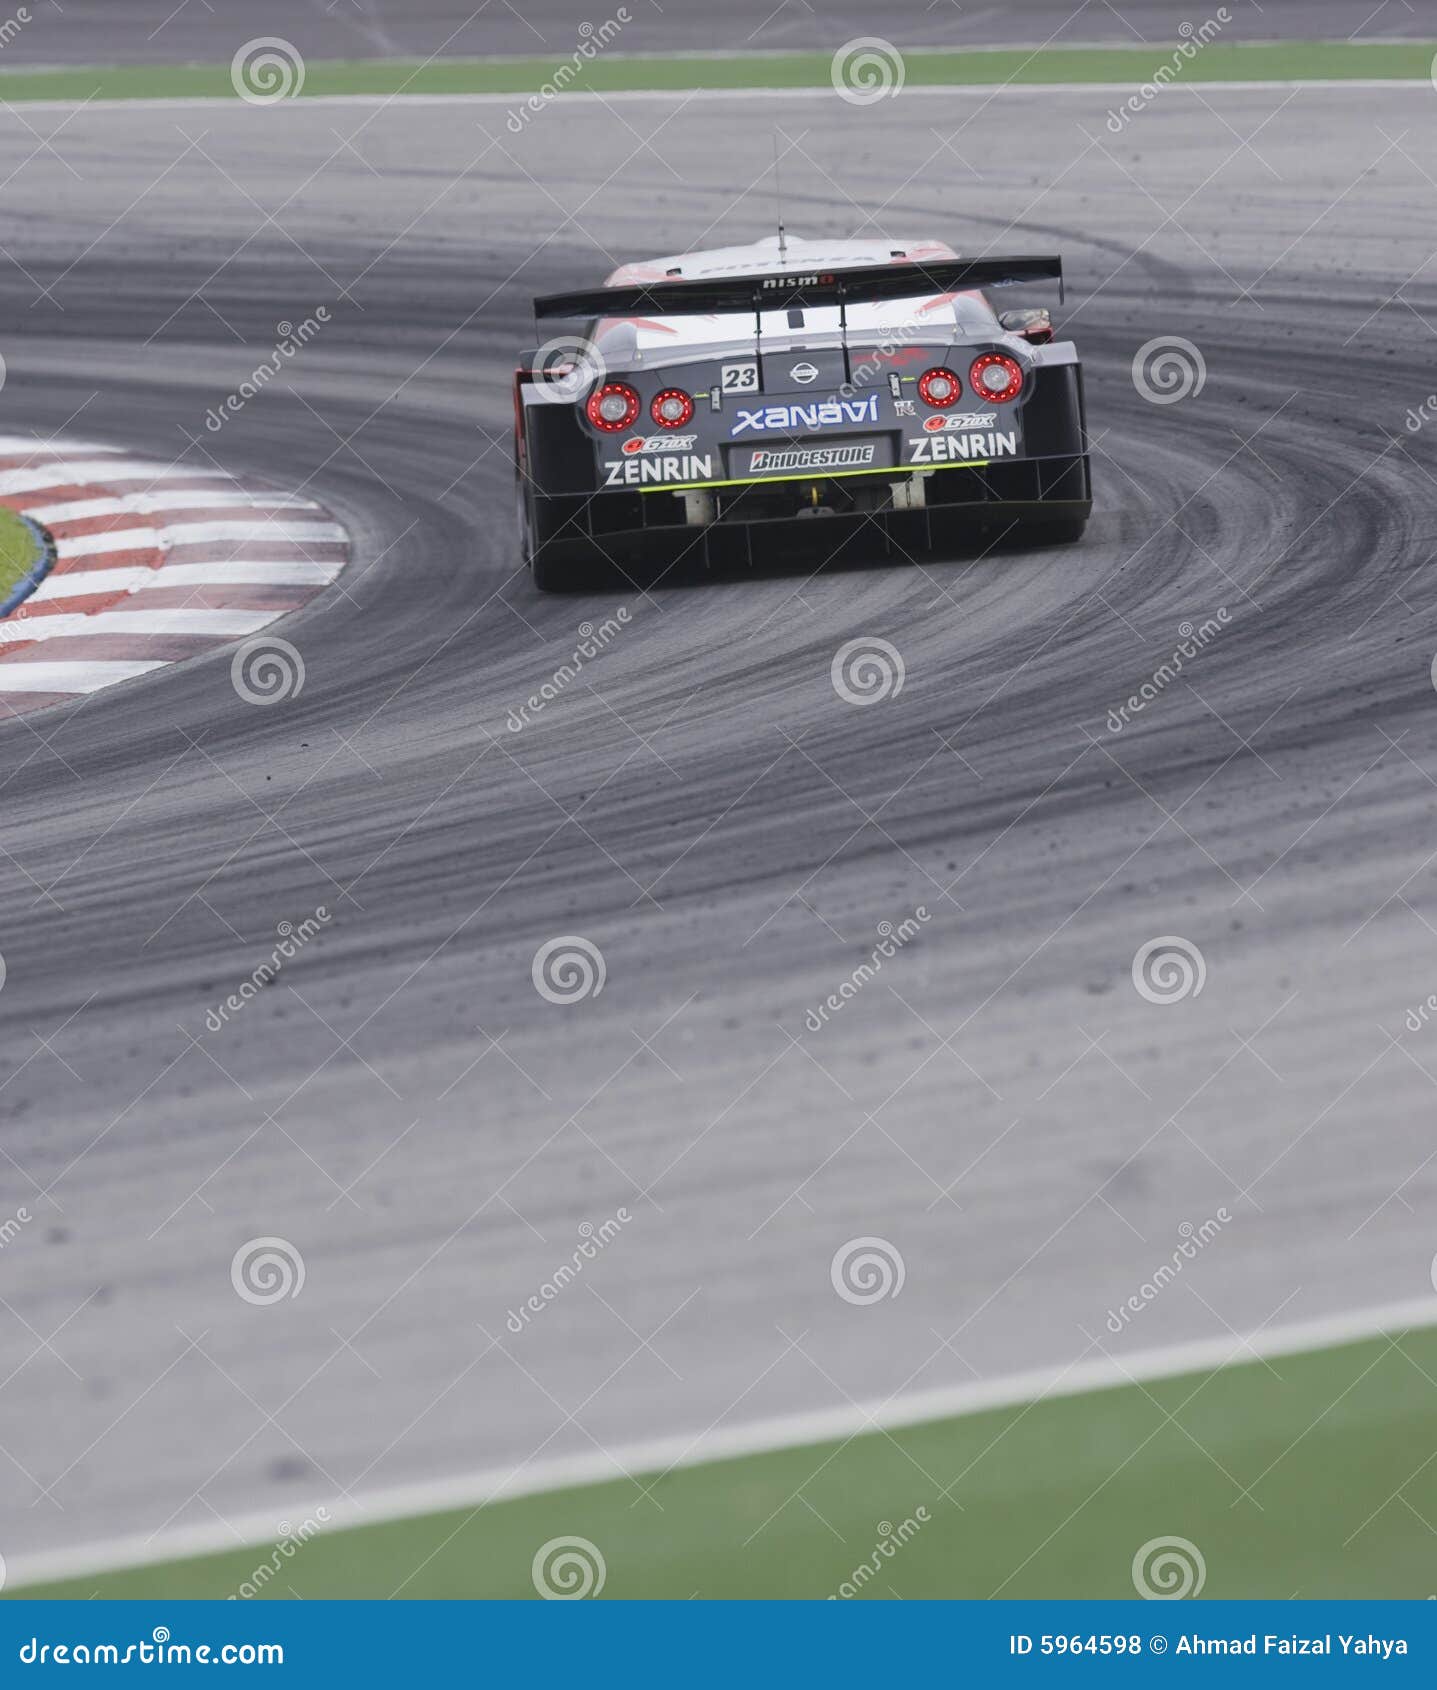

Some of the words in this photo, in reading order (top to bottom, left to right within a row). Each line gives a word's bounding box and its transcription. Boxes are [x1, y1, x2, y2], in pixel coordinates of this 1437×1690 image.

[763, 274, 836, 289] nismo
[724, 368, 756, 388] 23
[750, 446, 874, 472] BRIDGESTONE
[909, 431, 1017, 463] ZENRIN
[604, 454, 712, 486] ZENRIN
